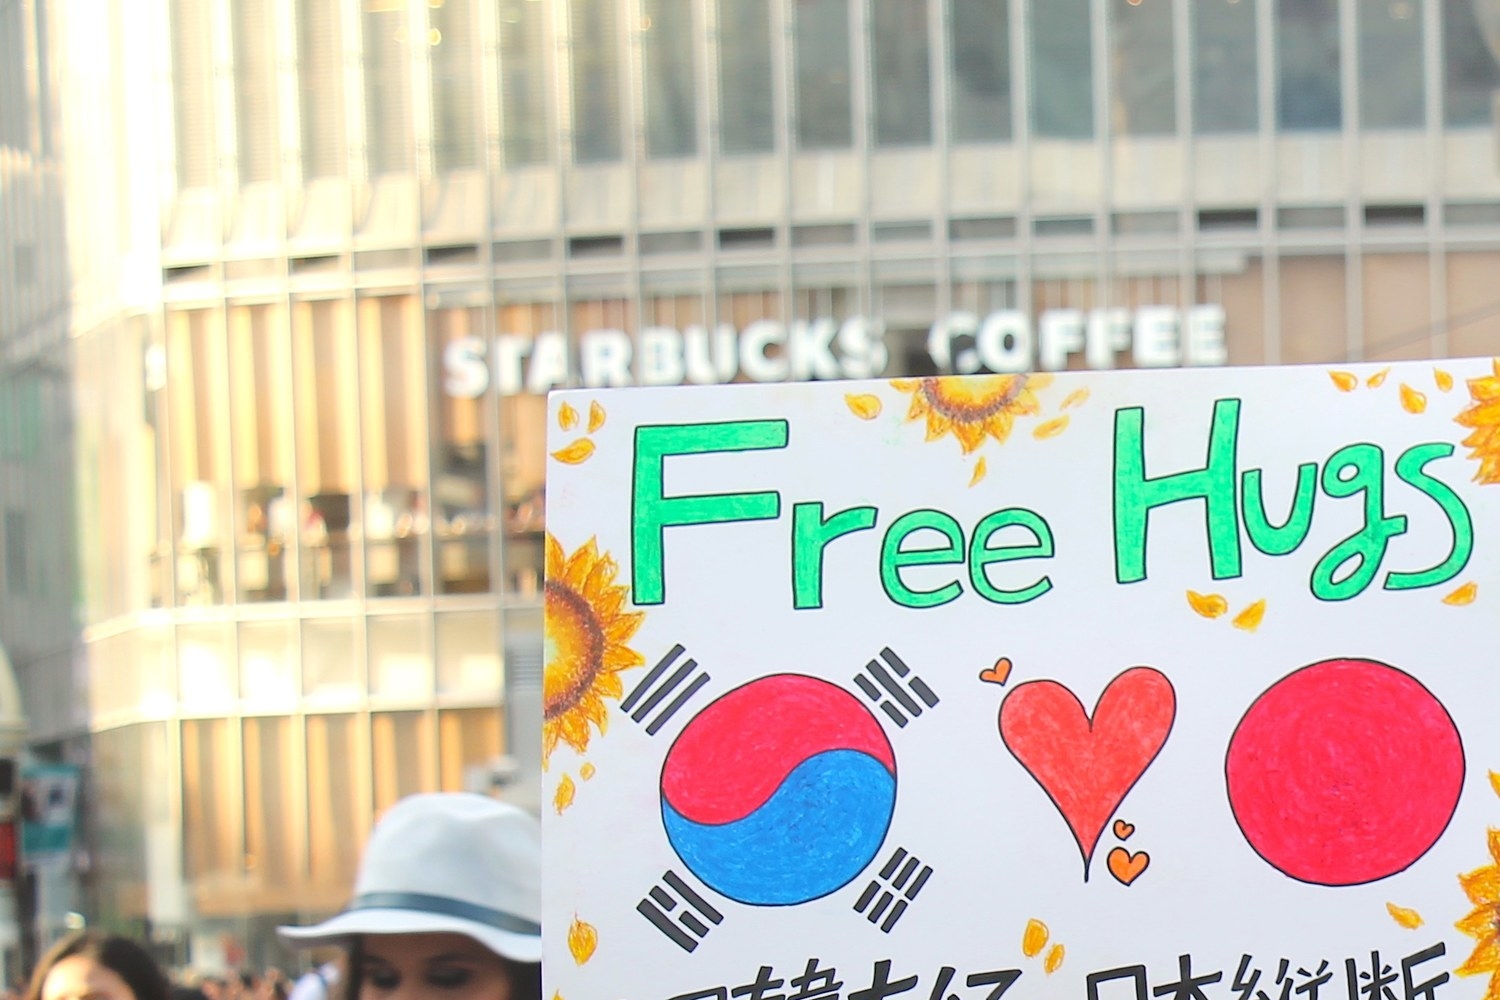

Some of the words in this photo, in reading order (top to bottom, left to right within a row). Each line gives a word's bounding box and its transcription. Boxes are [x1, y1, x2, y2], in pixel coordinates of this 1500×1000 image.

[443, 315, 889, 399] STARBUCKS
[927, 303, 1228, 375] COFFEE
[631, 420, 1054, 609] Free
[1113, 399, 1474, 600] Hugs
